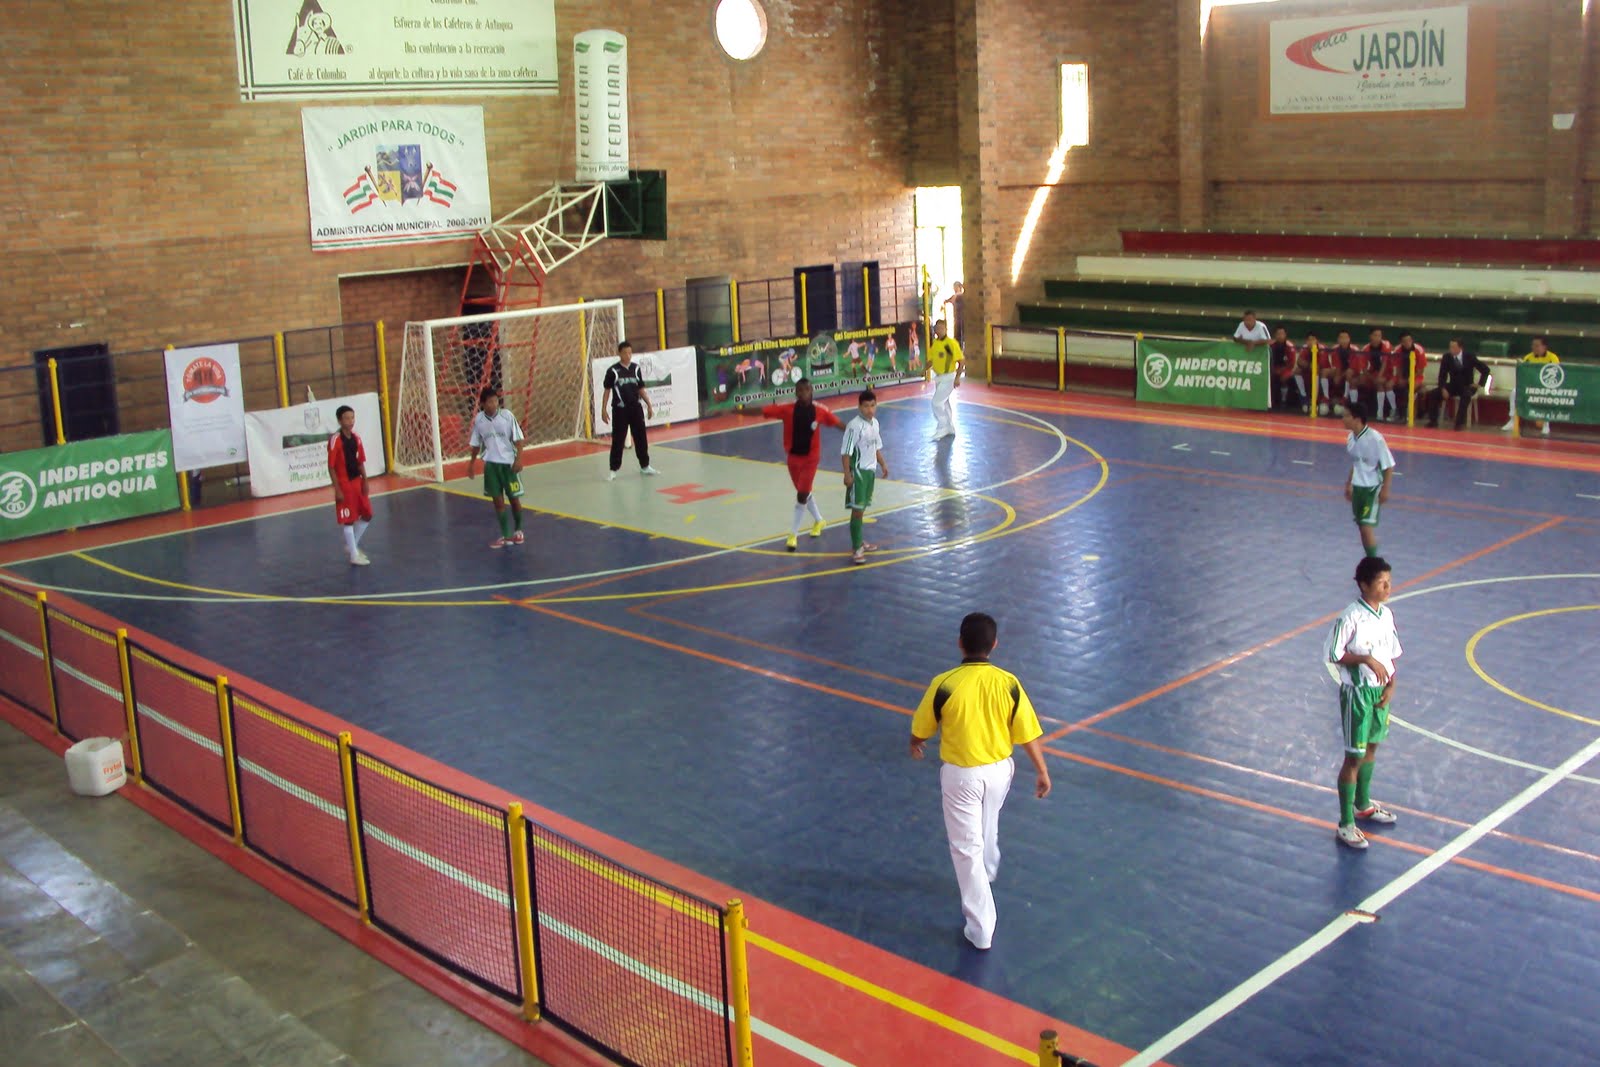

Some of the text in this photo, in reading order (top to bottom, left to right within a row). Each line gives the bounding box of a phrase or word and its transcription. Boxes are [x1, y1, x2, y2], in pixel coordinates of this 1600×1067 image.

[423, 17, 431, 29] de
[433, 17, 442, 29] los
[443, 17, 473, 30] Cafeteros
[475, 19, 482, 30] de
[485, 18, 513, 32] Antioquia
[404, 42, 416, 54] Una
[458, 45, 463, 54] a
[465, 43, 473, 54] la
[1353, 19, 1445, 72] JARDÍN
[288, 67, 347, 80] Café de Colombia
[368, 67, 375, 80] al
[402, 67, 410, 79] la
[411, 67, 434, 79] cultura
[436, 70, 441, 81] y
[442, 66, 449, 78] la
[464, 70, 479, 79] sana
[481, 67, 488, 78] de
[490, 66, 496, 78] la
[512, 66, 538, 78] cafetera
[337, 122, 378, 149] JARDIN
[382, 120, 413, 132] PARA
[417, 121, 456, 145] TODOS
[316, 221, 394, 237] ADMINISTRACIÓN
[396, 219, 443, 232] MUNICIPAL
[754, 343, 762, 351] de
[834, 331, 844, 341] del
[844, 329, 868, 340] Suroeste
[1174, 357, 1263, 375] INDEPORTES
[1173, 374, 1252, 391] ANTIOQUIA
[1525, 387, 1578, 397] INDEPORTES
[1527, 396, 1575, 406] ANTIOQUIA
[39, 450, 168, 488] INDEPORTES
[43, 475, 157, 509] ANTIOQUIA
[510, 482, 519, 492] 10
[340, 507, 350, 519] 10
